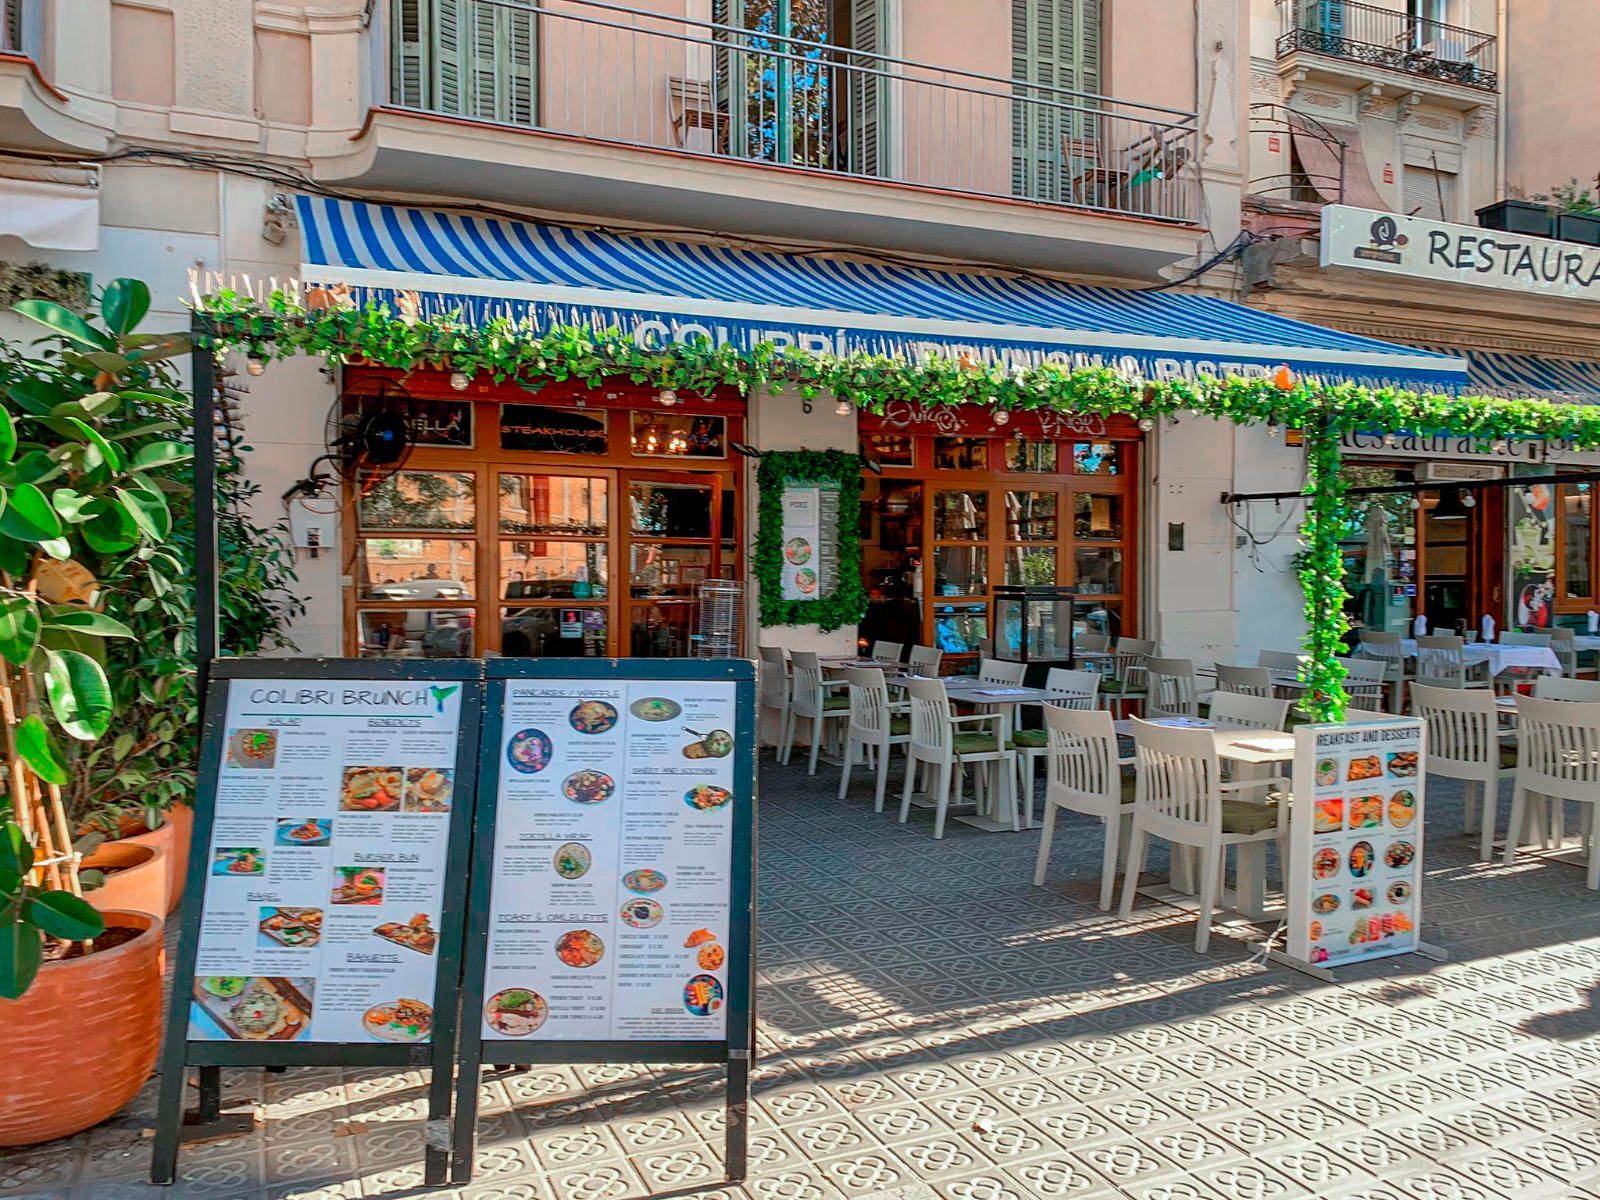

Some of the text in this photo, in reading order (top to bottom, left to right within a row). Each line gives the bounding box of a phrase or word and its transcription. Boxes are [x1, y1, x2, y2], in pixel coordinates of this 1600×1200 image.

[501, 425, 607, 439] STEAKHOUSE
[250, 689, 428, 706] COLIBRI BRUNCH
